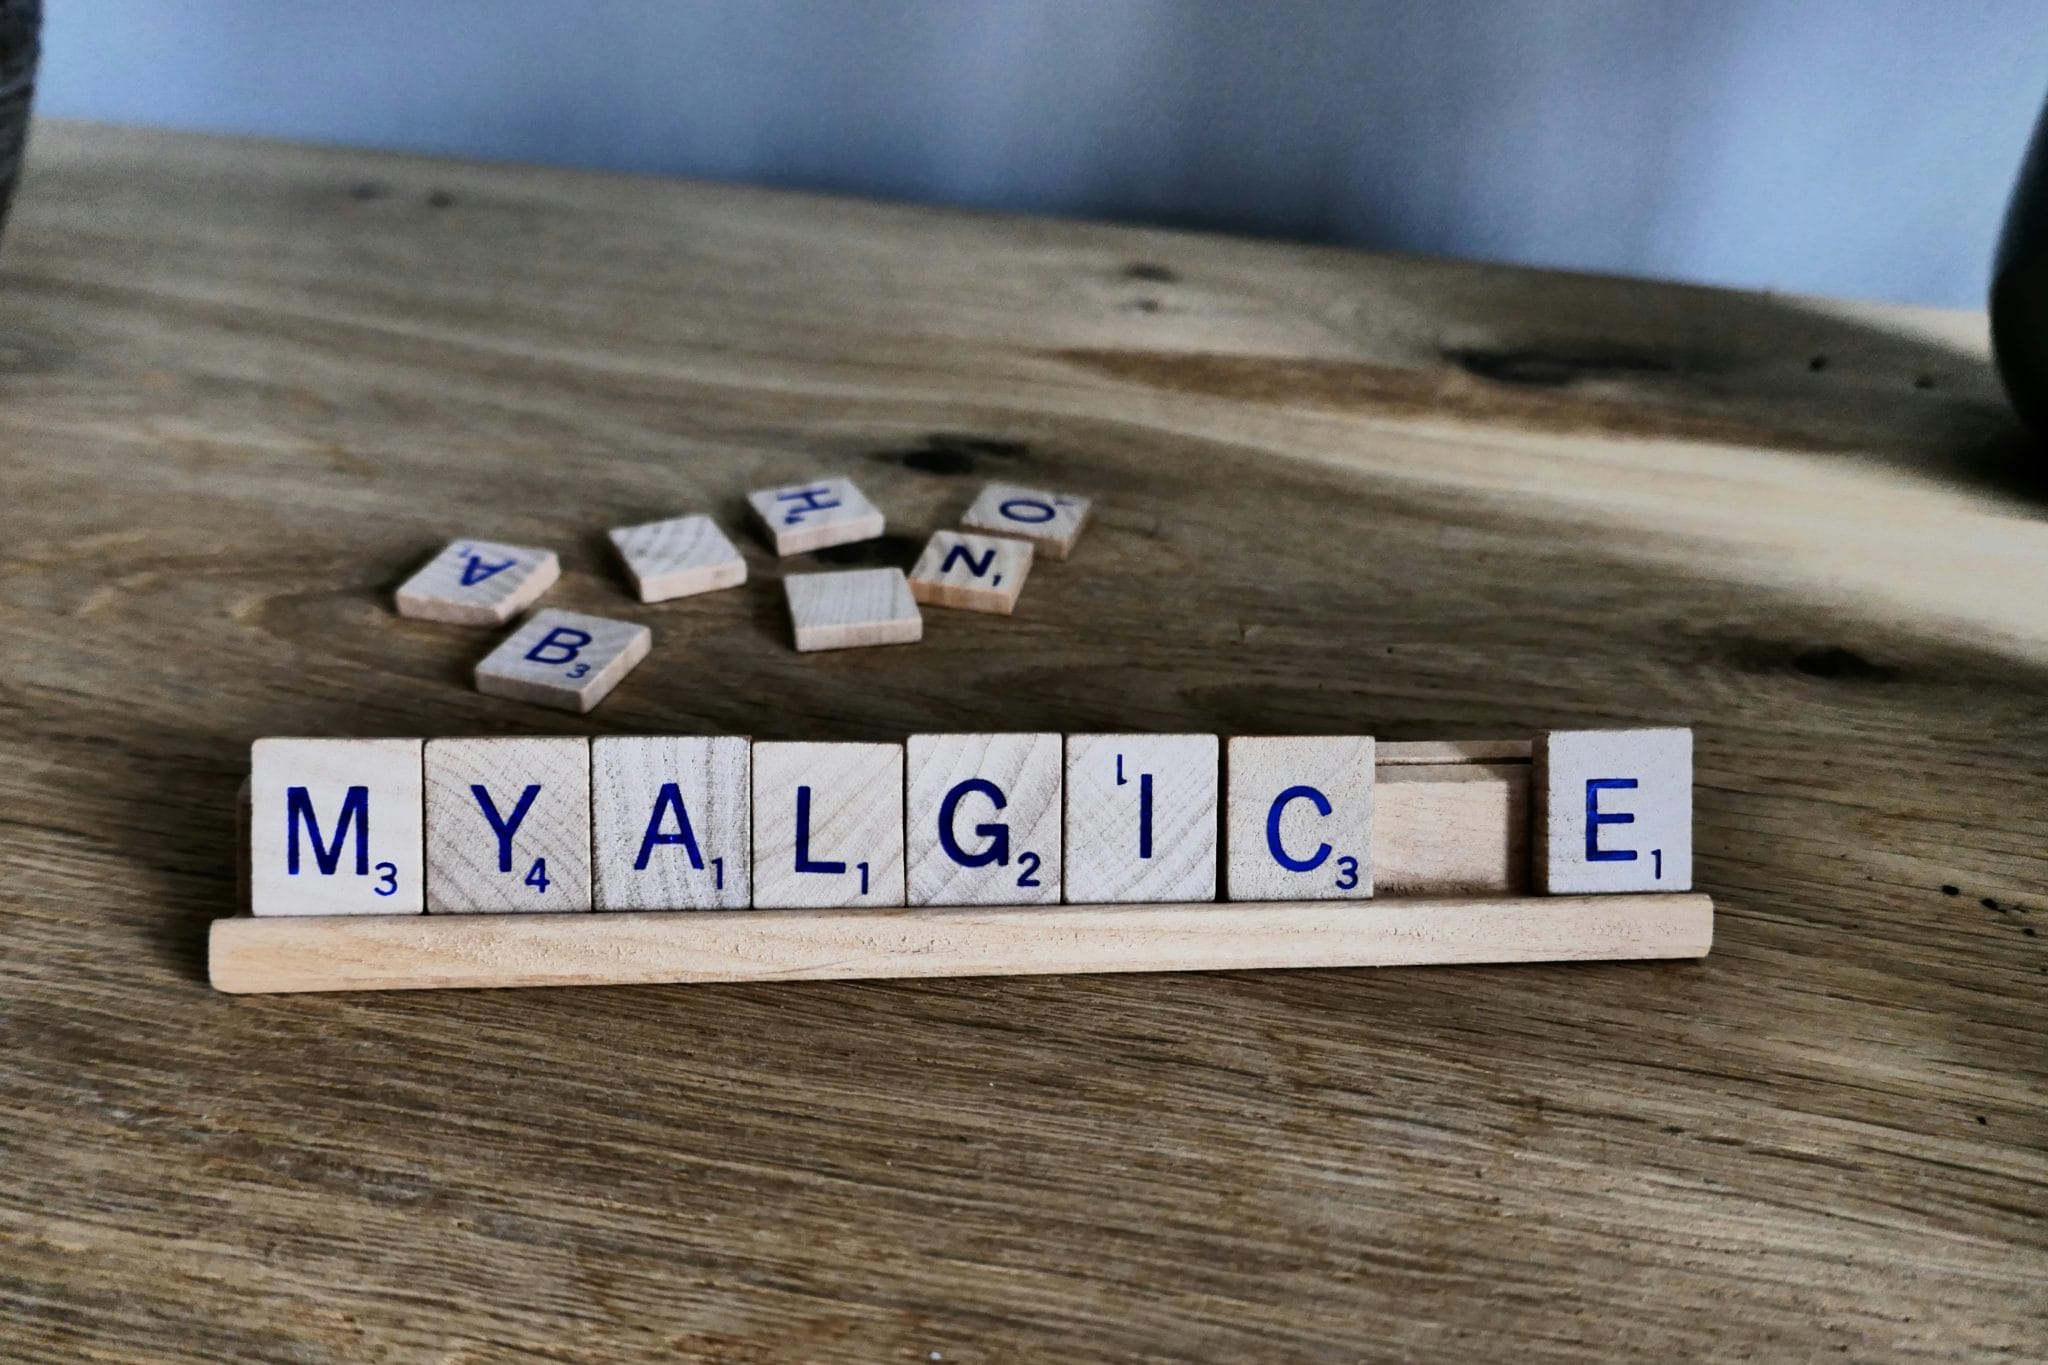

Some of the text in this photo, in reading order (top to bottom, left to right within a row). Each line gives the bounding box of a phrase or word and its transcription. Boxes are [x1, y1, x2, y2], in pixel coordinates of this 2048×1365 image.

[459, 555, 517, 587] A
[940, 544, 996, 577] N
[523, 626, 592, 665] B
[566, 663, 590, 679] 3
[1585, 777, 1639, 863] E
[373, 861, 398, 896] 3
[525, 857, 551, 894] 4
[1016, 851, 1040, 888] 2
[1335, 855, 1359, 890] 3
